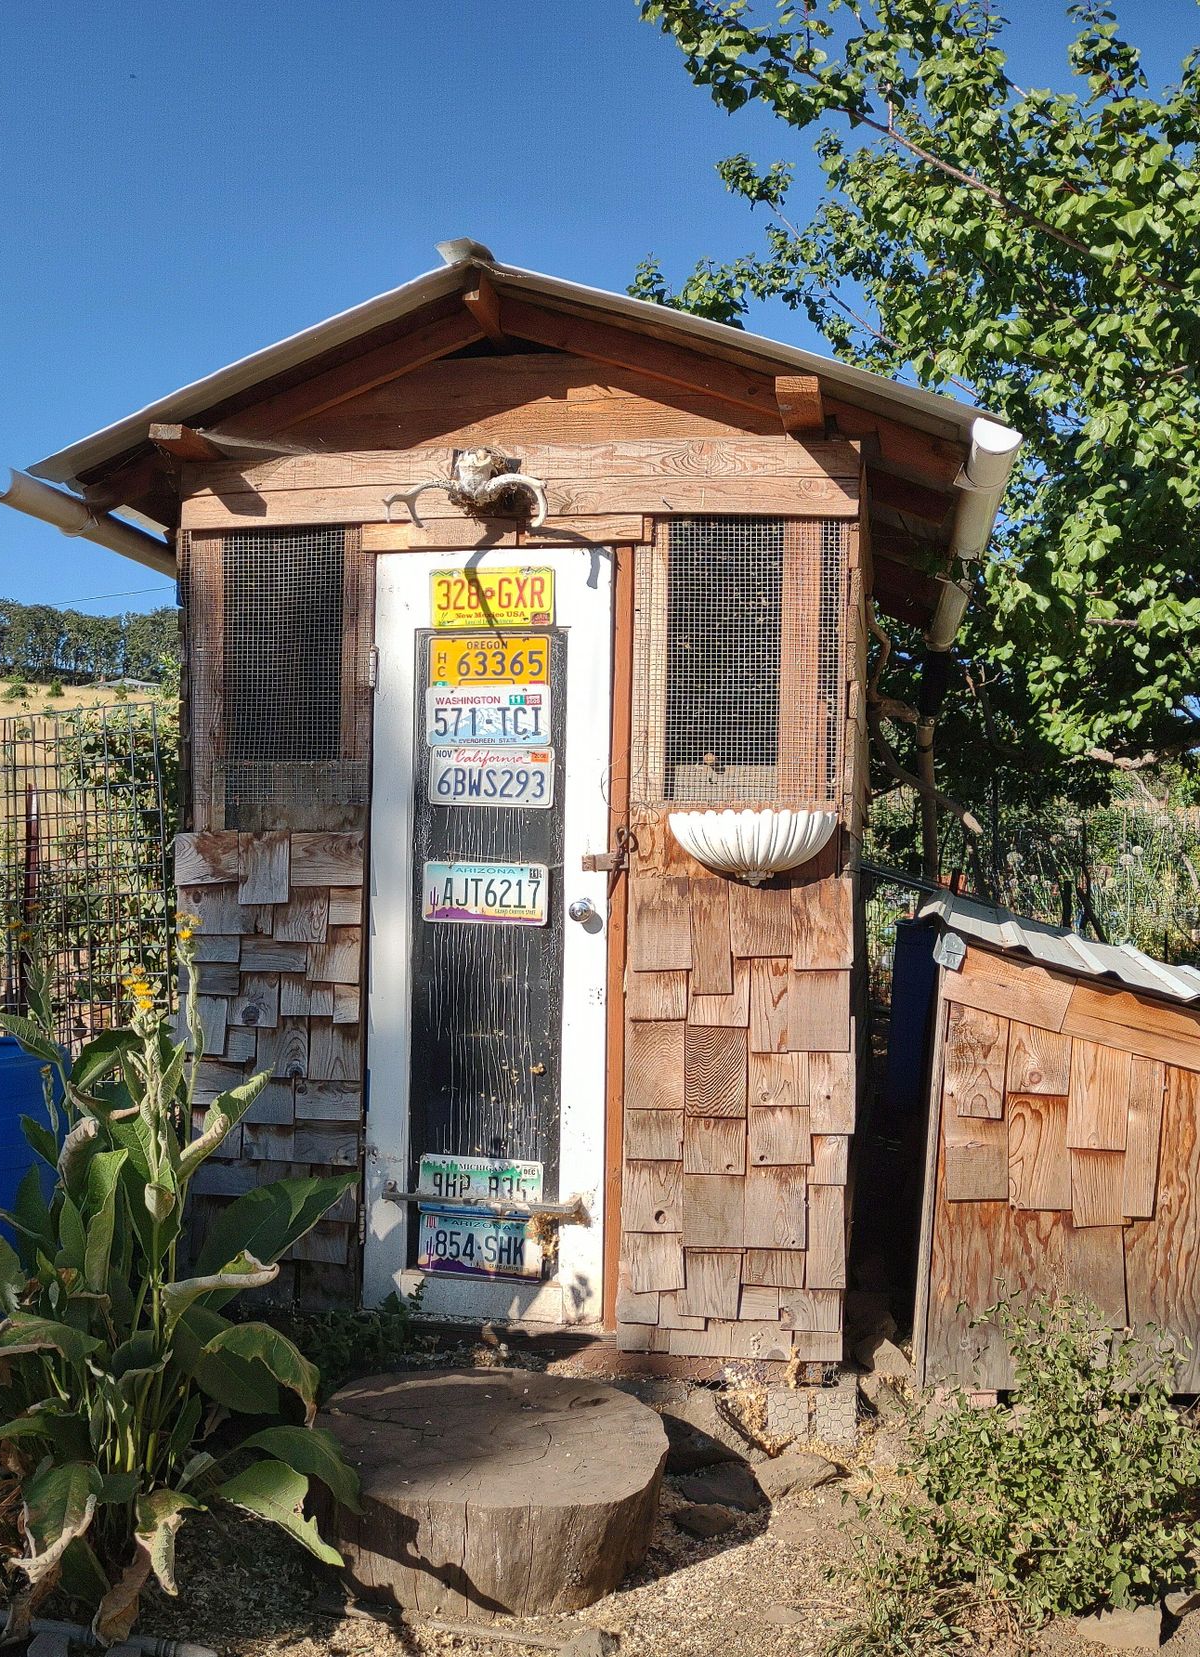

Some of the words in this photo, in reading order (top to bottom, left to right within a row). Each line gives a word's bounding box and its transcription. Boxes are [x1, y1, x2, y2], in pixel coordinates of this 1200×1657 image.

[437, 578, 480, 610] 328
[498, 576, 545, 609] GXR
[474, 611, 505, 619] Mexico
[506, 610, 525, 618] USA
[466, 641, 508, 650] OREGON
[457, 650, 544, 676] 63365
[435, 695, 501, 705] WASHINGTON
[434, 706, 542, 737] 571-TCI
[436, 750, 453, 758] NOV
[454, 749, 531, 767] California
[437, 767, 545, 798] 6BWS293
[455, 867, 516, 875] ARIZONA
[442, 877, 540, 909] AJT6217
[459, 1163, 504, 1172] MICHIGAN
[523, 1168, 536, 1176] DEC
[426, 1215, 437, 1228] JUL
[451, 1220, 511, 1231] ARIZONA
